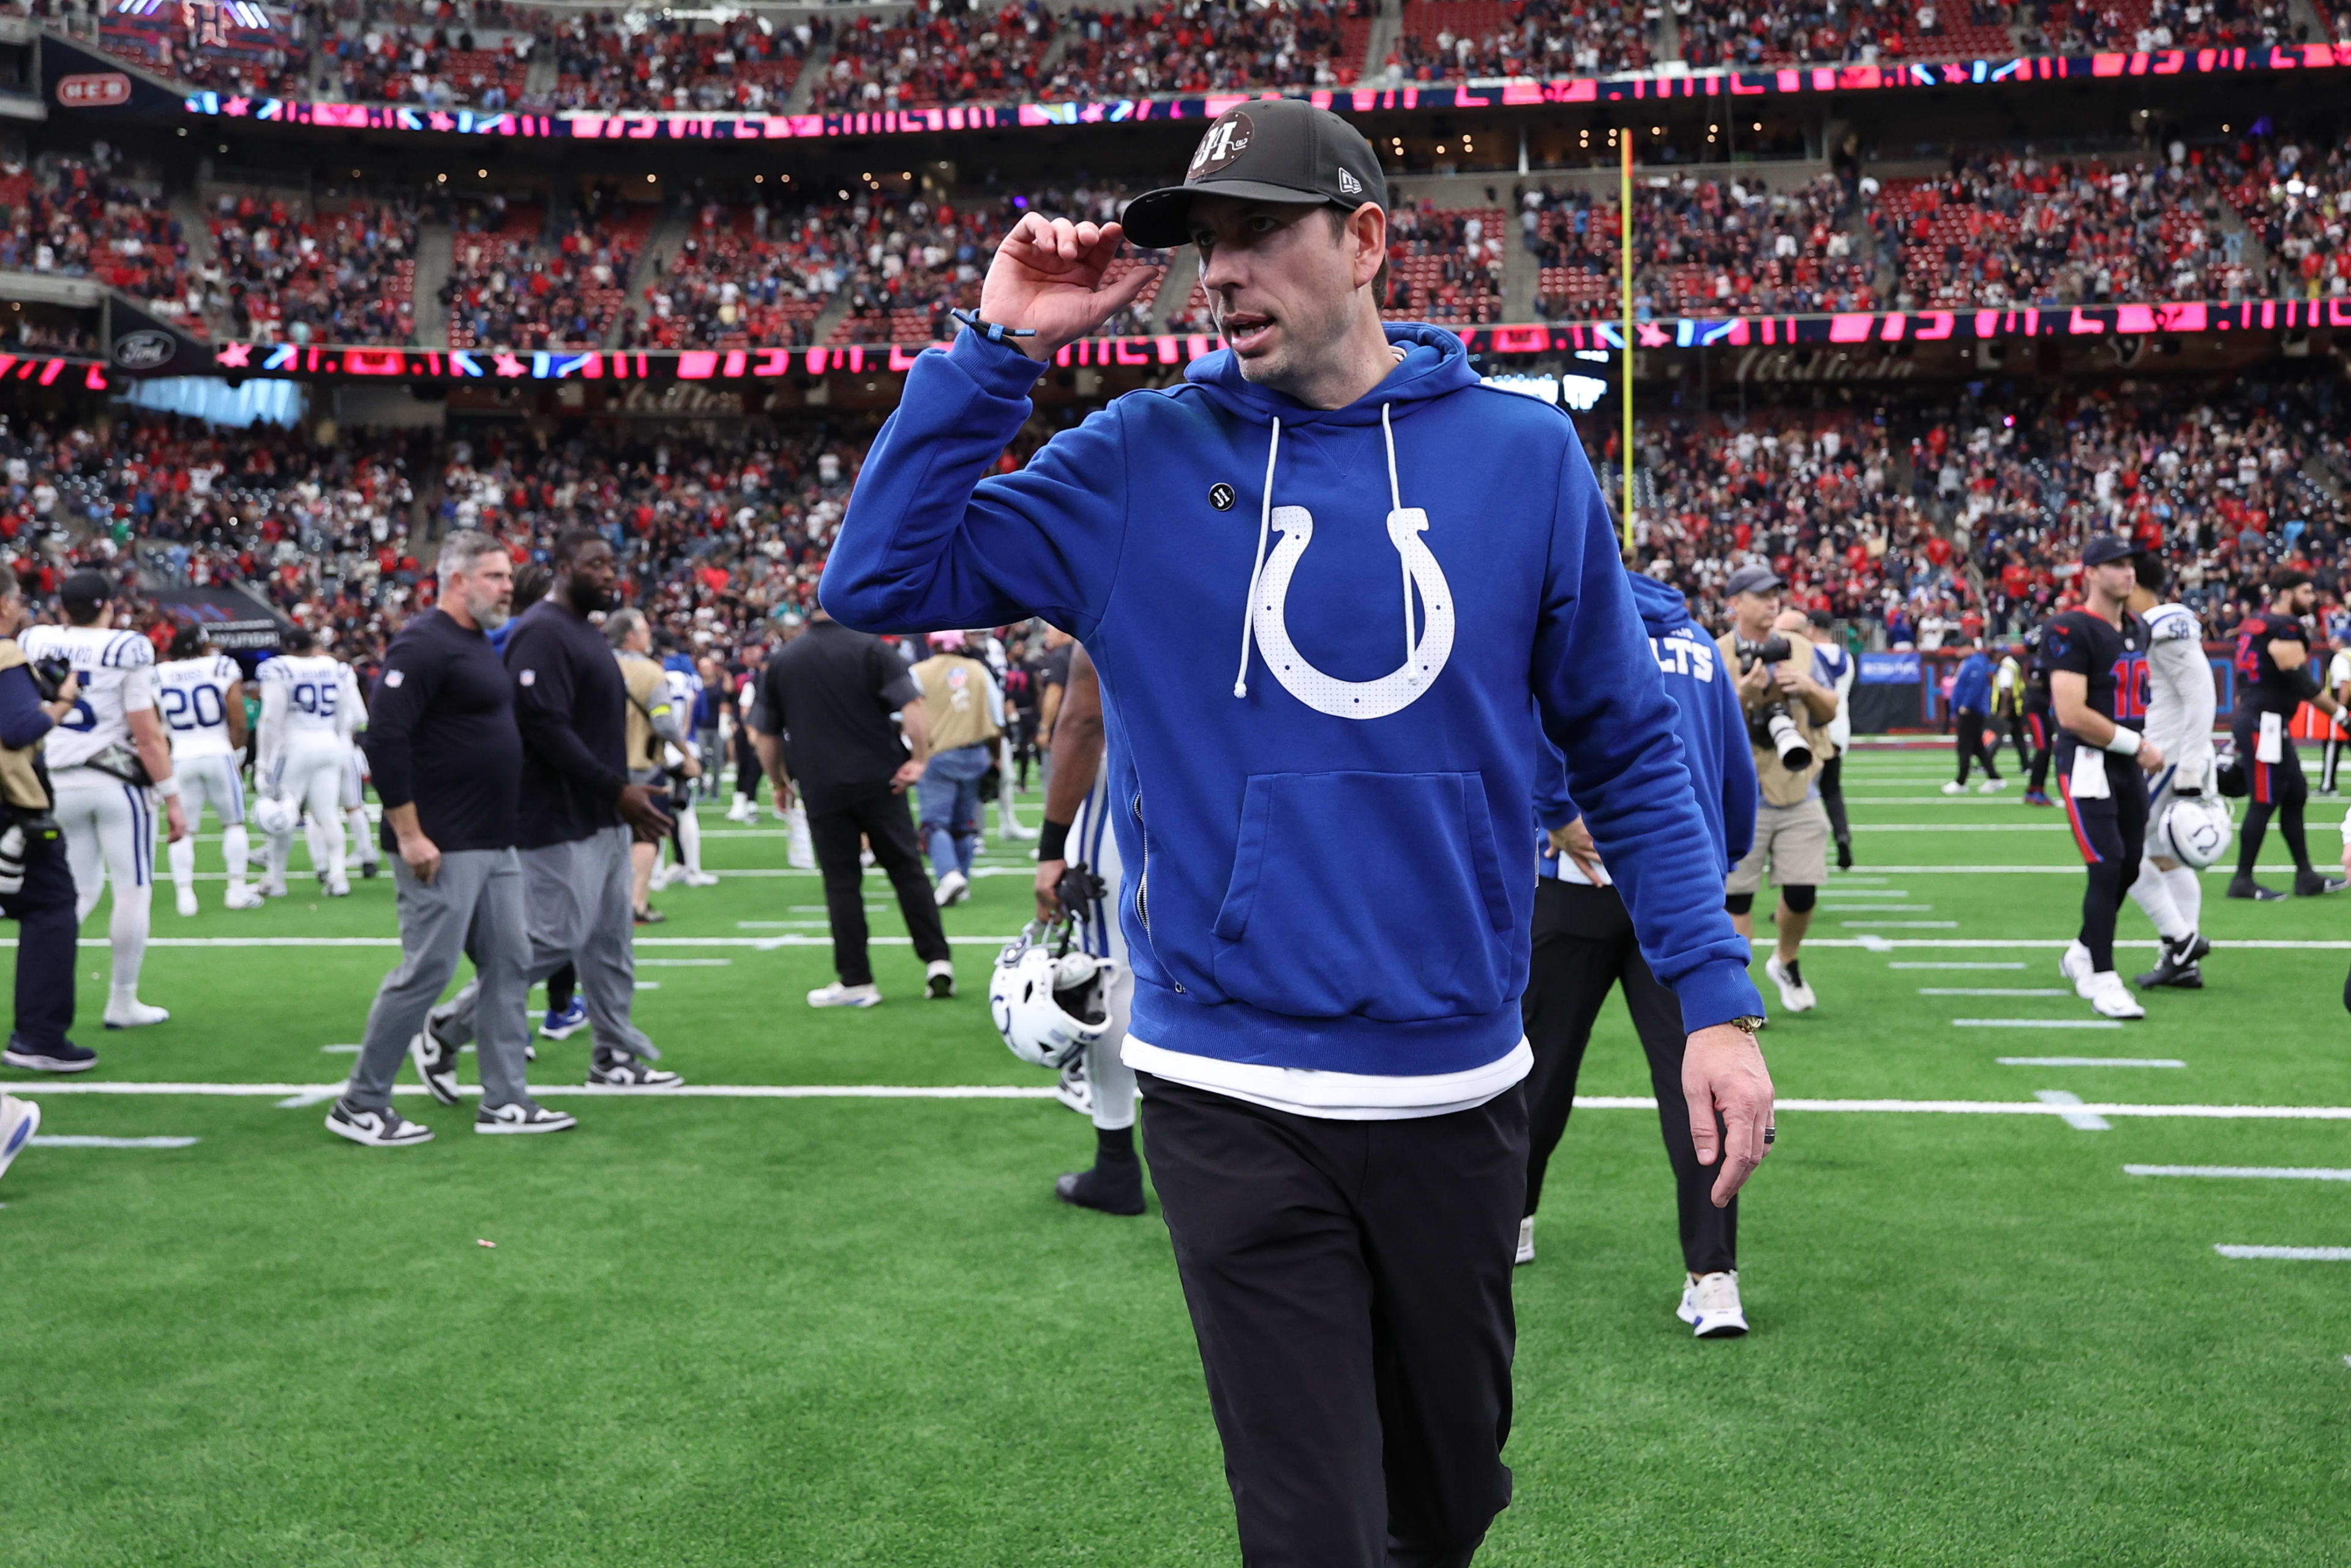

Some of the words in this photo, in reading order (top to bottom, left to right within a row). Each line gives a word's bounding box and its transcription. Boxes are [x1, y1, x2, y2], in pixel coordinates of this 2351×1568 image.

[162, 684, 227, 730] 20
[294, 684, 337, 717] 95
[2109, 656, 2151, 720] 10
